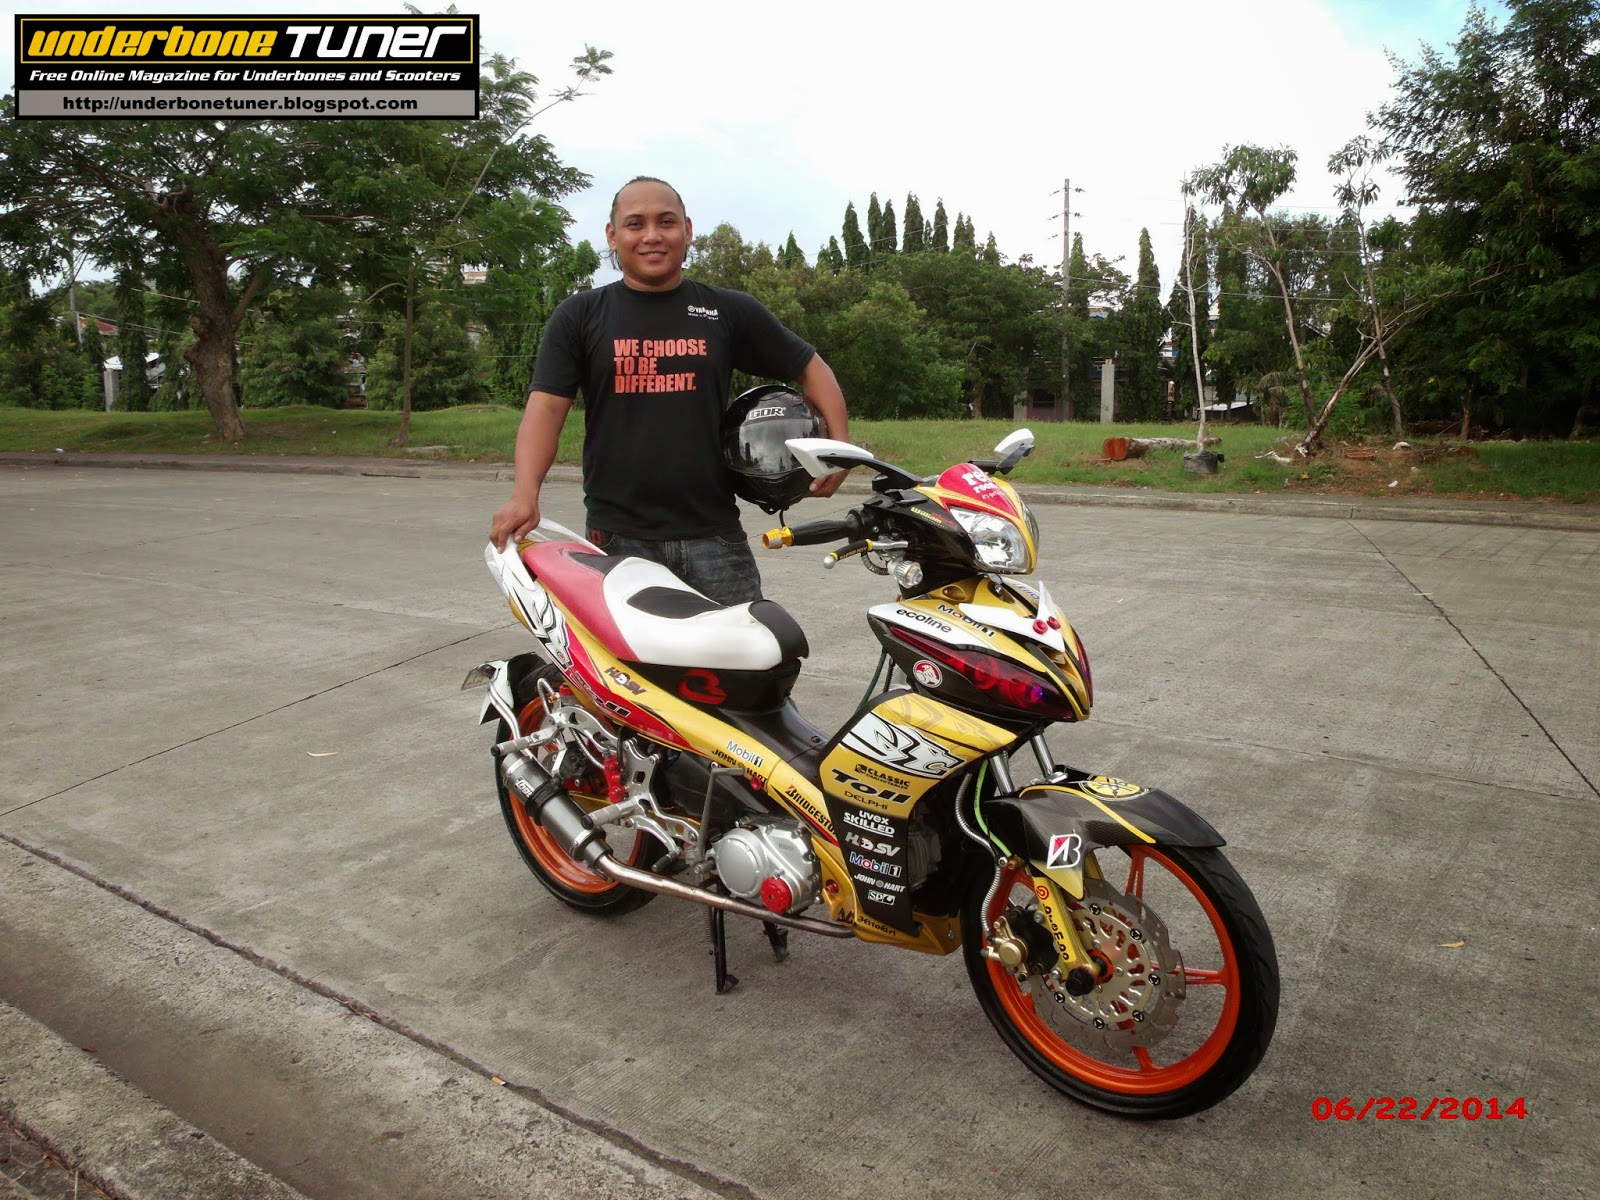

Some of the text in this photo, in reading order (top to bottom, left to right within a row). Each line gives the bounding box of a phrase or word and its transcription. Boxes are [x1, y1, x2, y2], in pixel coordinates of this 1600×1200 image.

[614, 338, 707, 357] WE CHOOSE
[614, 356, 657, 375] TO BE
[614, 373, 696, 393] DIFFERENT.
[896, 608, 952, 633] ecoline
[711, 749, 737, 766] JOHN
[726, 740, 755, 763] Mobil
[831, 768, 912, 805] Toll
[867, 768, 911, 787] CLASSIC
[844, 790, 888, 810] DELPHI
[843, 812, 896, 836] SKILLED
[858, 810, 890, 826] uvex
[849, 851, 889, 875] Mobil
[854, 873, 906, 893] JOHN HART
